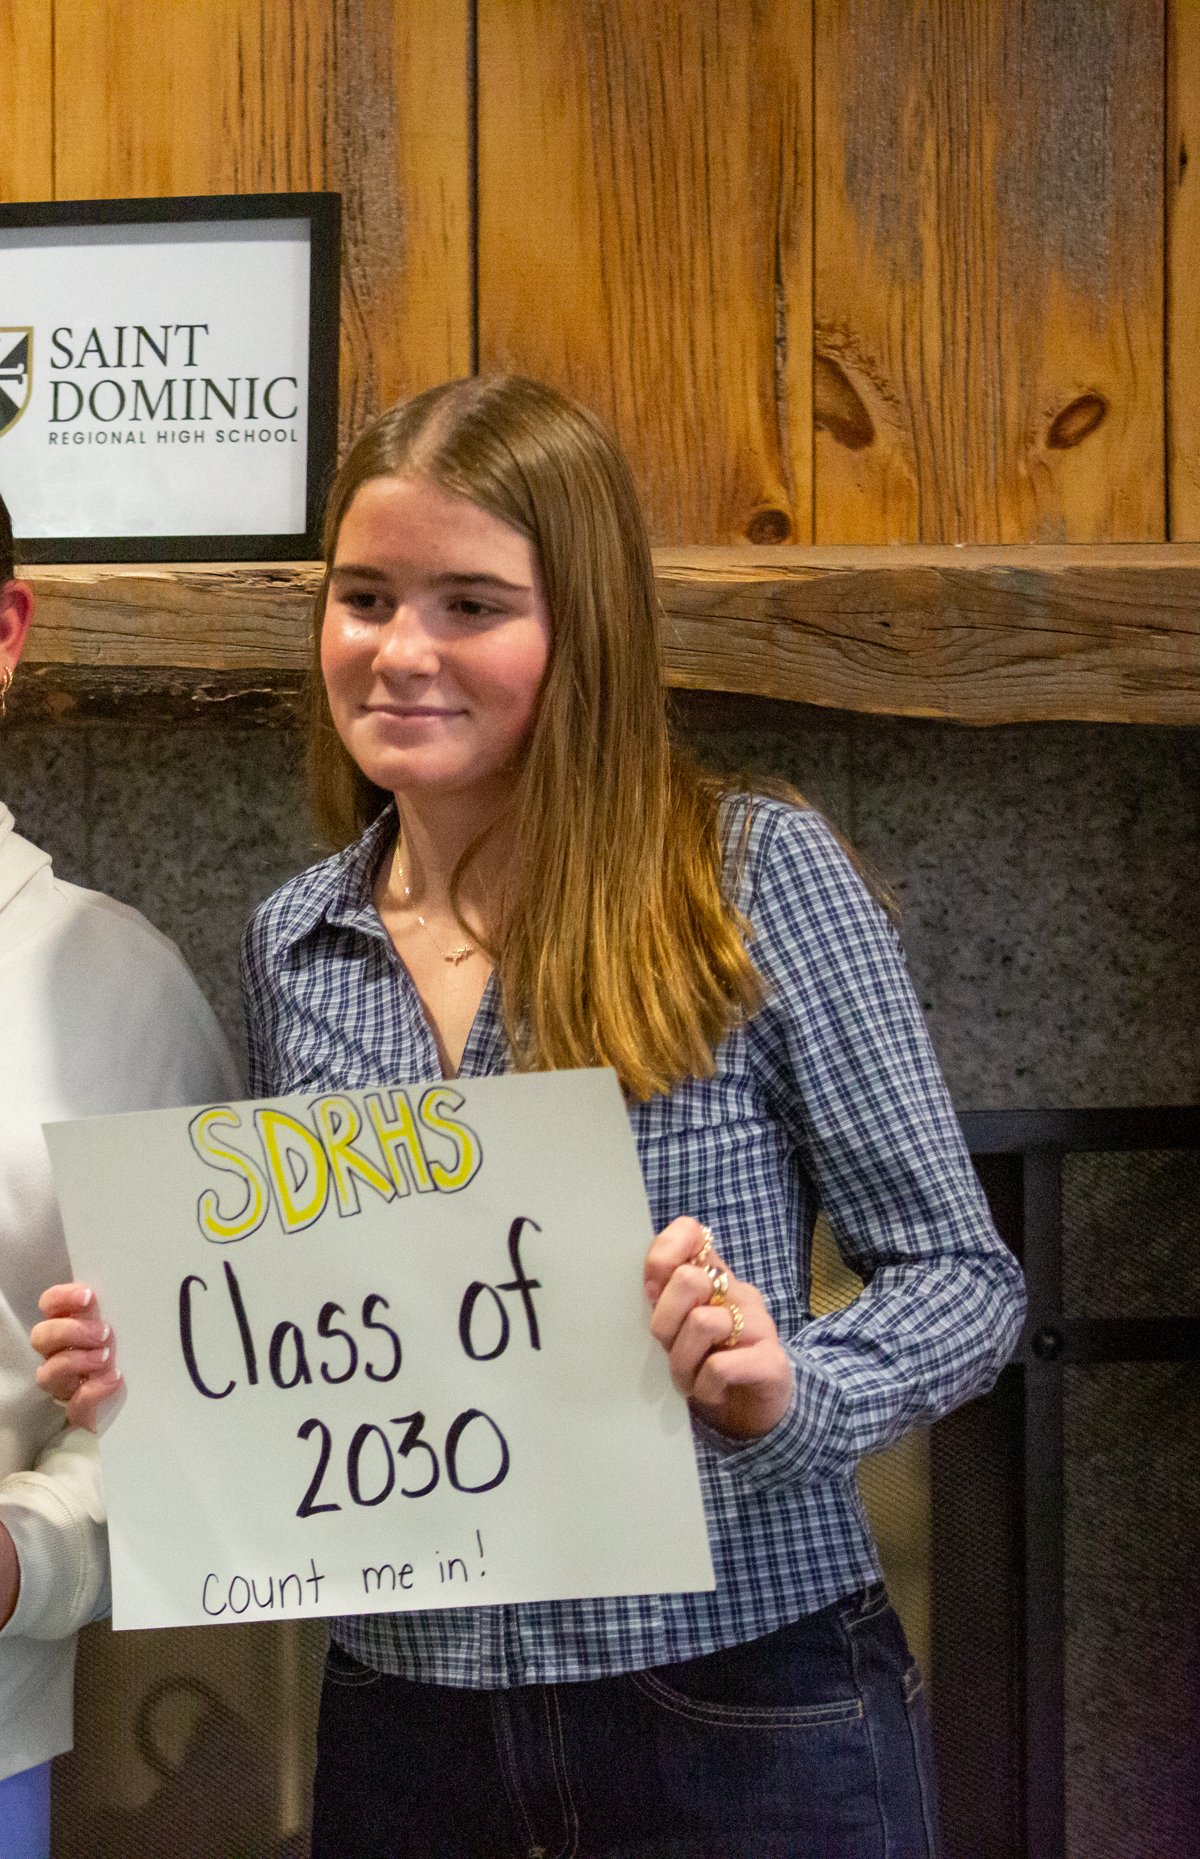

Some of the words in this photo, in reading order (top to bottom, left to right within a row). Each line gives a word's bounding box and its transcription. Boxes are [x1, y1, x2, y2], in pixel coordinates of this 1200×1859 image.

[50, 324, 208, 369] SAINT
[48, 376, 298, 422] DOMINIC
[49, 431, 146, 445] REGIONAL
[157, 430, 205, 444] HIGH
[216, 429, 297, 443] SCHOOL
[188, 1087, 484, 1244] SDRHS
[178, 1260, 402, 1399] Class
[459, 1216, 541, 1361] of
[296, 1408, 510, 1519] 2030
[362, 1563, 414, 1593] me
[436, 1529, 488, 1583] in!
